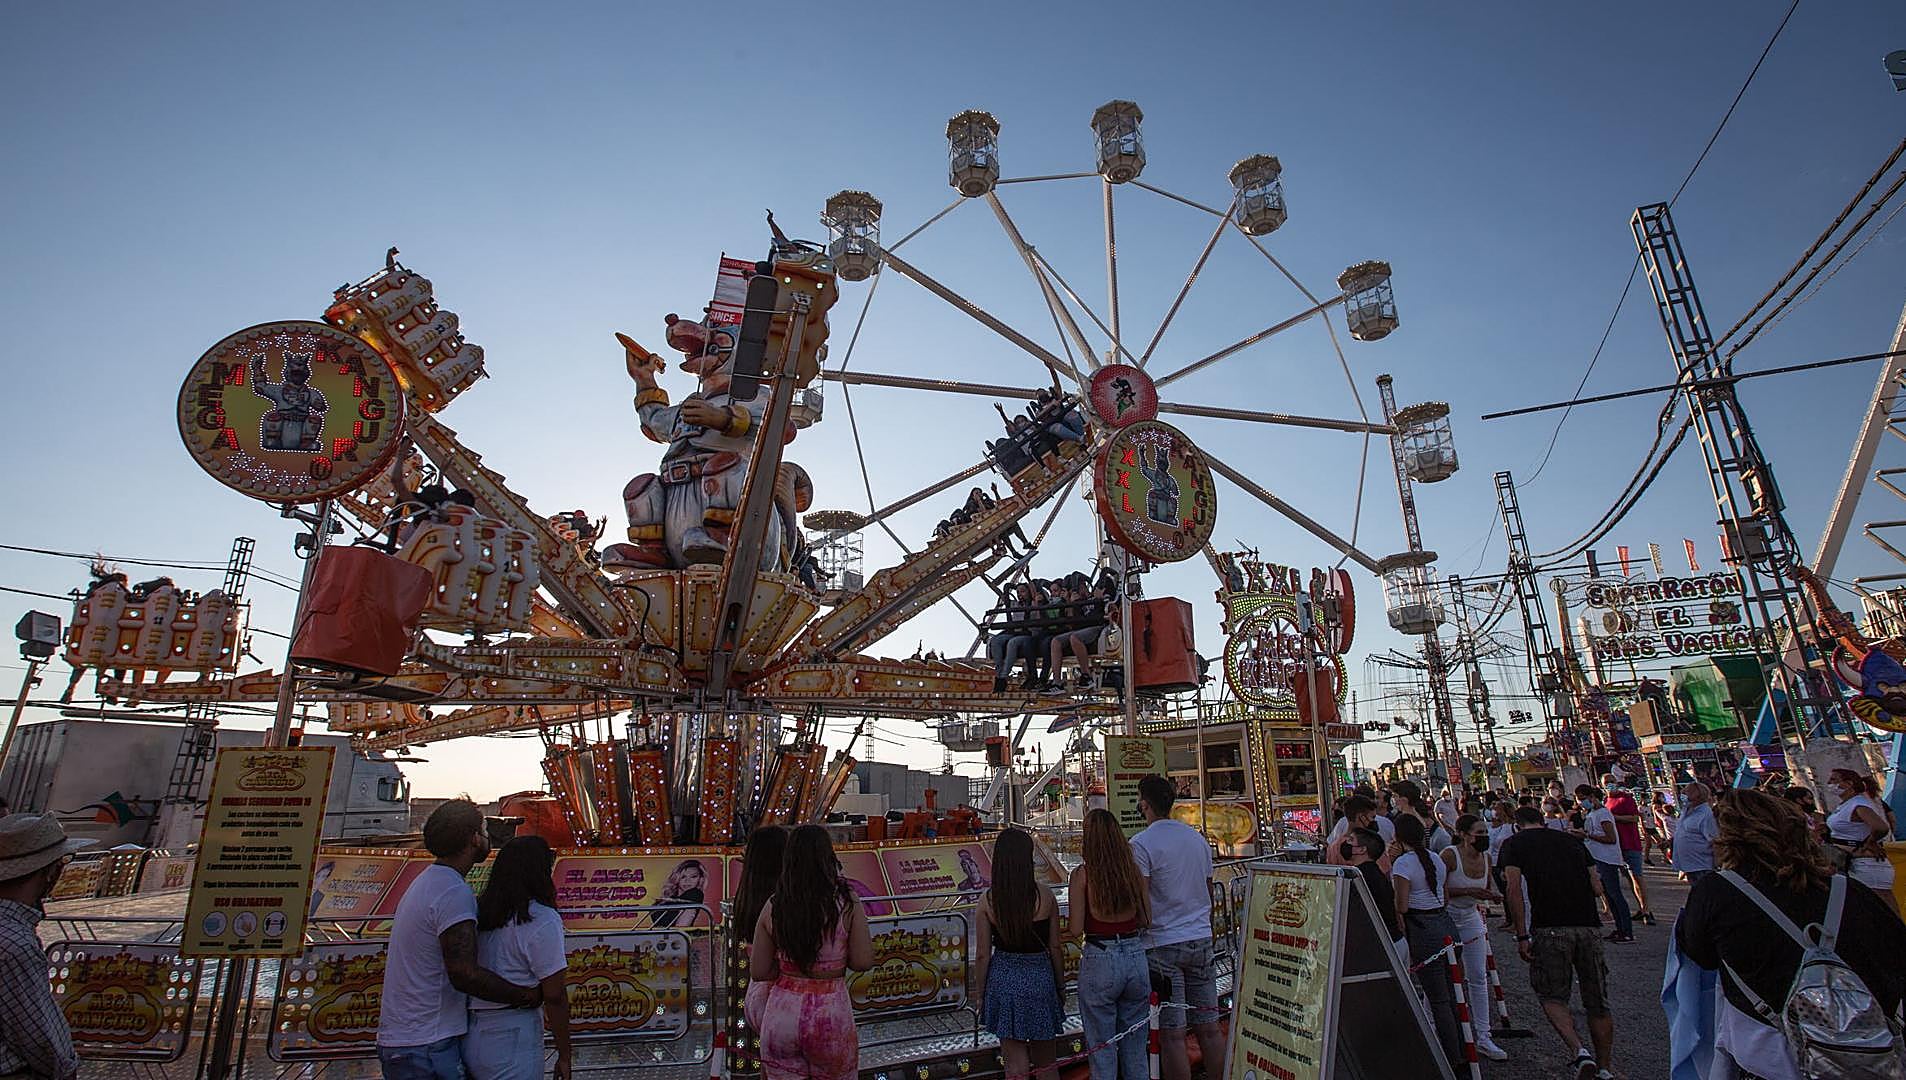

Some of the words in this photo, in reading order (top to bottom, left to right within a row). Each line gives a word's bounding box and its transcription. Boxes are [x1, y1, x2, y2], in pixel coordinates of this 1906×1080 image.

[708, 310, 736, 322] SINCE
[197, 362, 246, 451] MEGA
[310, 343, 385, 480] KANGURO
[1115, 449, 1135, 513] XXL
[1655, 606, 1694, 630] EL
[591, 868, 644, 883] MEGA
[555, 886, 647, 901] KANGURO
[573, 983, 622, 1002] MEGA
[570, 996, 644, 1019] NSACIÓN
